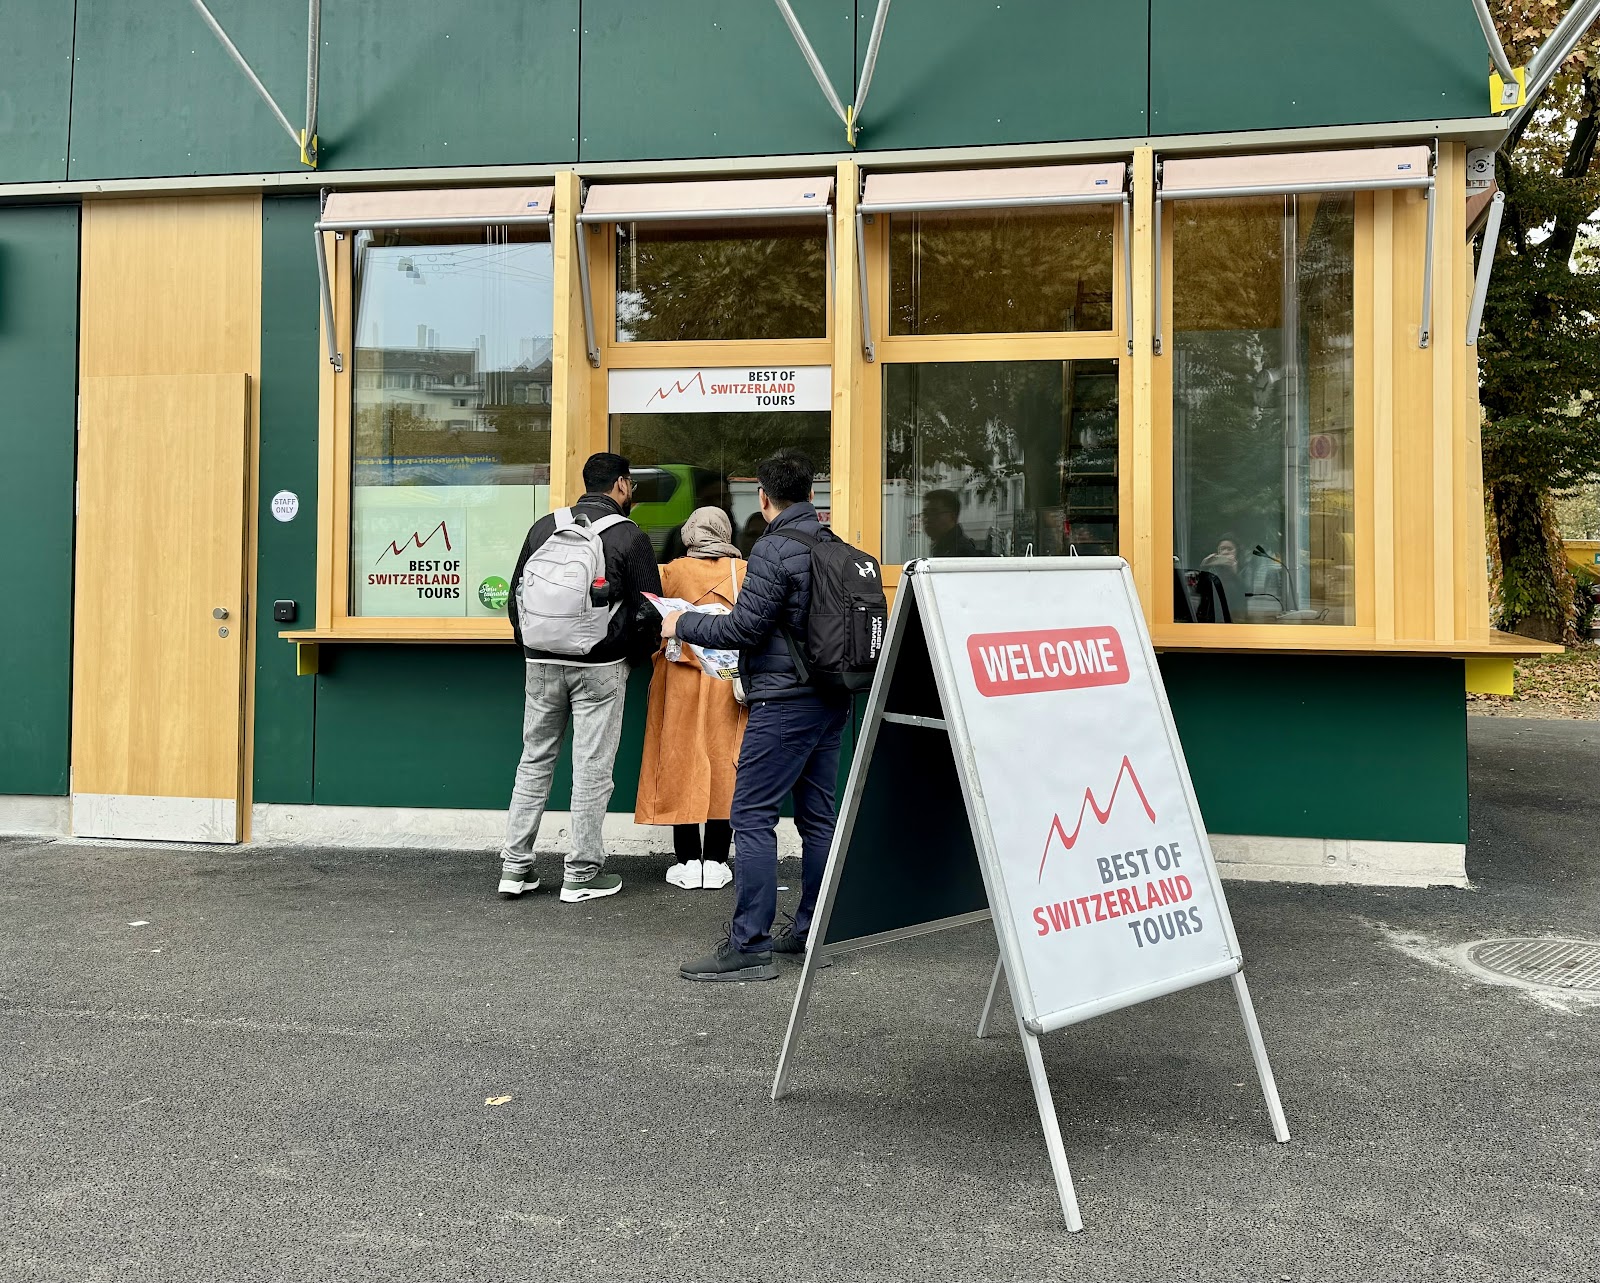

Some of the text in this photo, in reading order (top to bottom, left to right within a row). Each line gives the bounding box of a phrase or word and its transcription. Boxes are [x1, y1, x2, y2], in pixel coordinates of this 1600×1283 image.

[748, 371, 795, 381] BEST OF
[711, 383, 795, 394] SWITZERLAND
[756, 395, 795, 406] TOURS
[409, 560, 460, 571] BEST OF
[368, 574, 460, 585] SWITZERLAND
[417, 587, 460, 599] TOURS
[978, 638, 1118, 682] WELCOME
[1096, 842, 1182, 884] BEST OF
[1032, 874, 1193, 936] SWITZERLAND
[1128, 906, 1203, 948] TOURS
